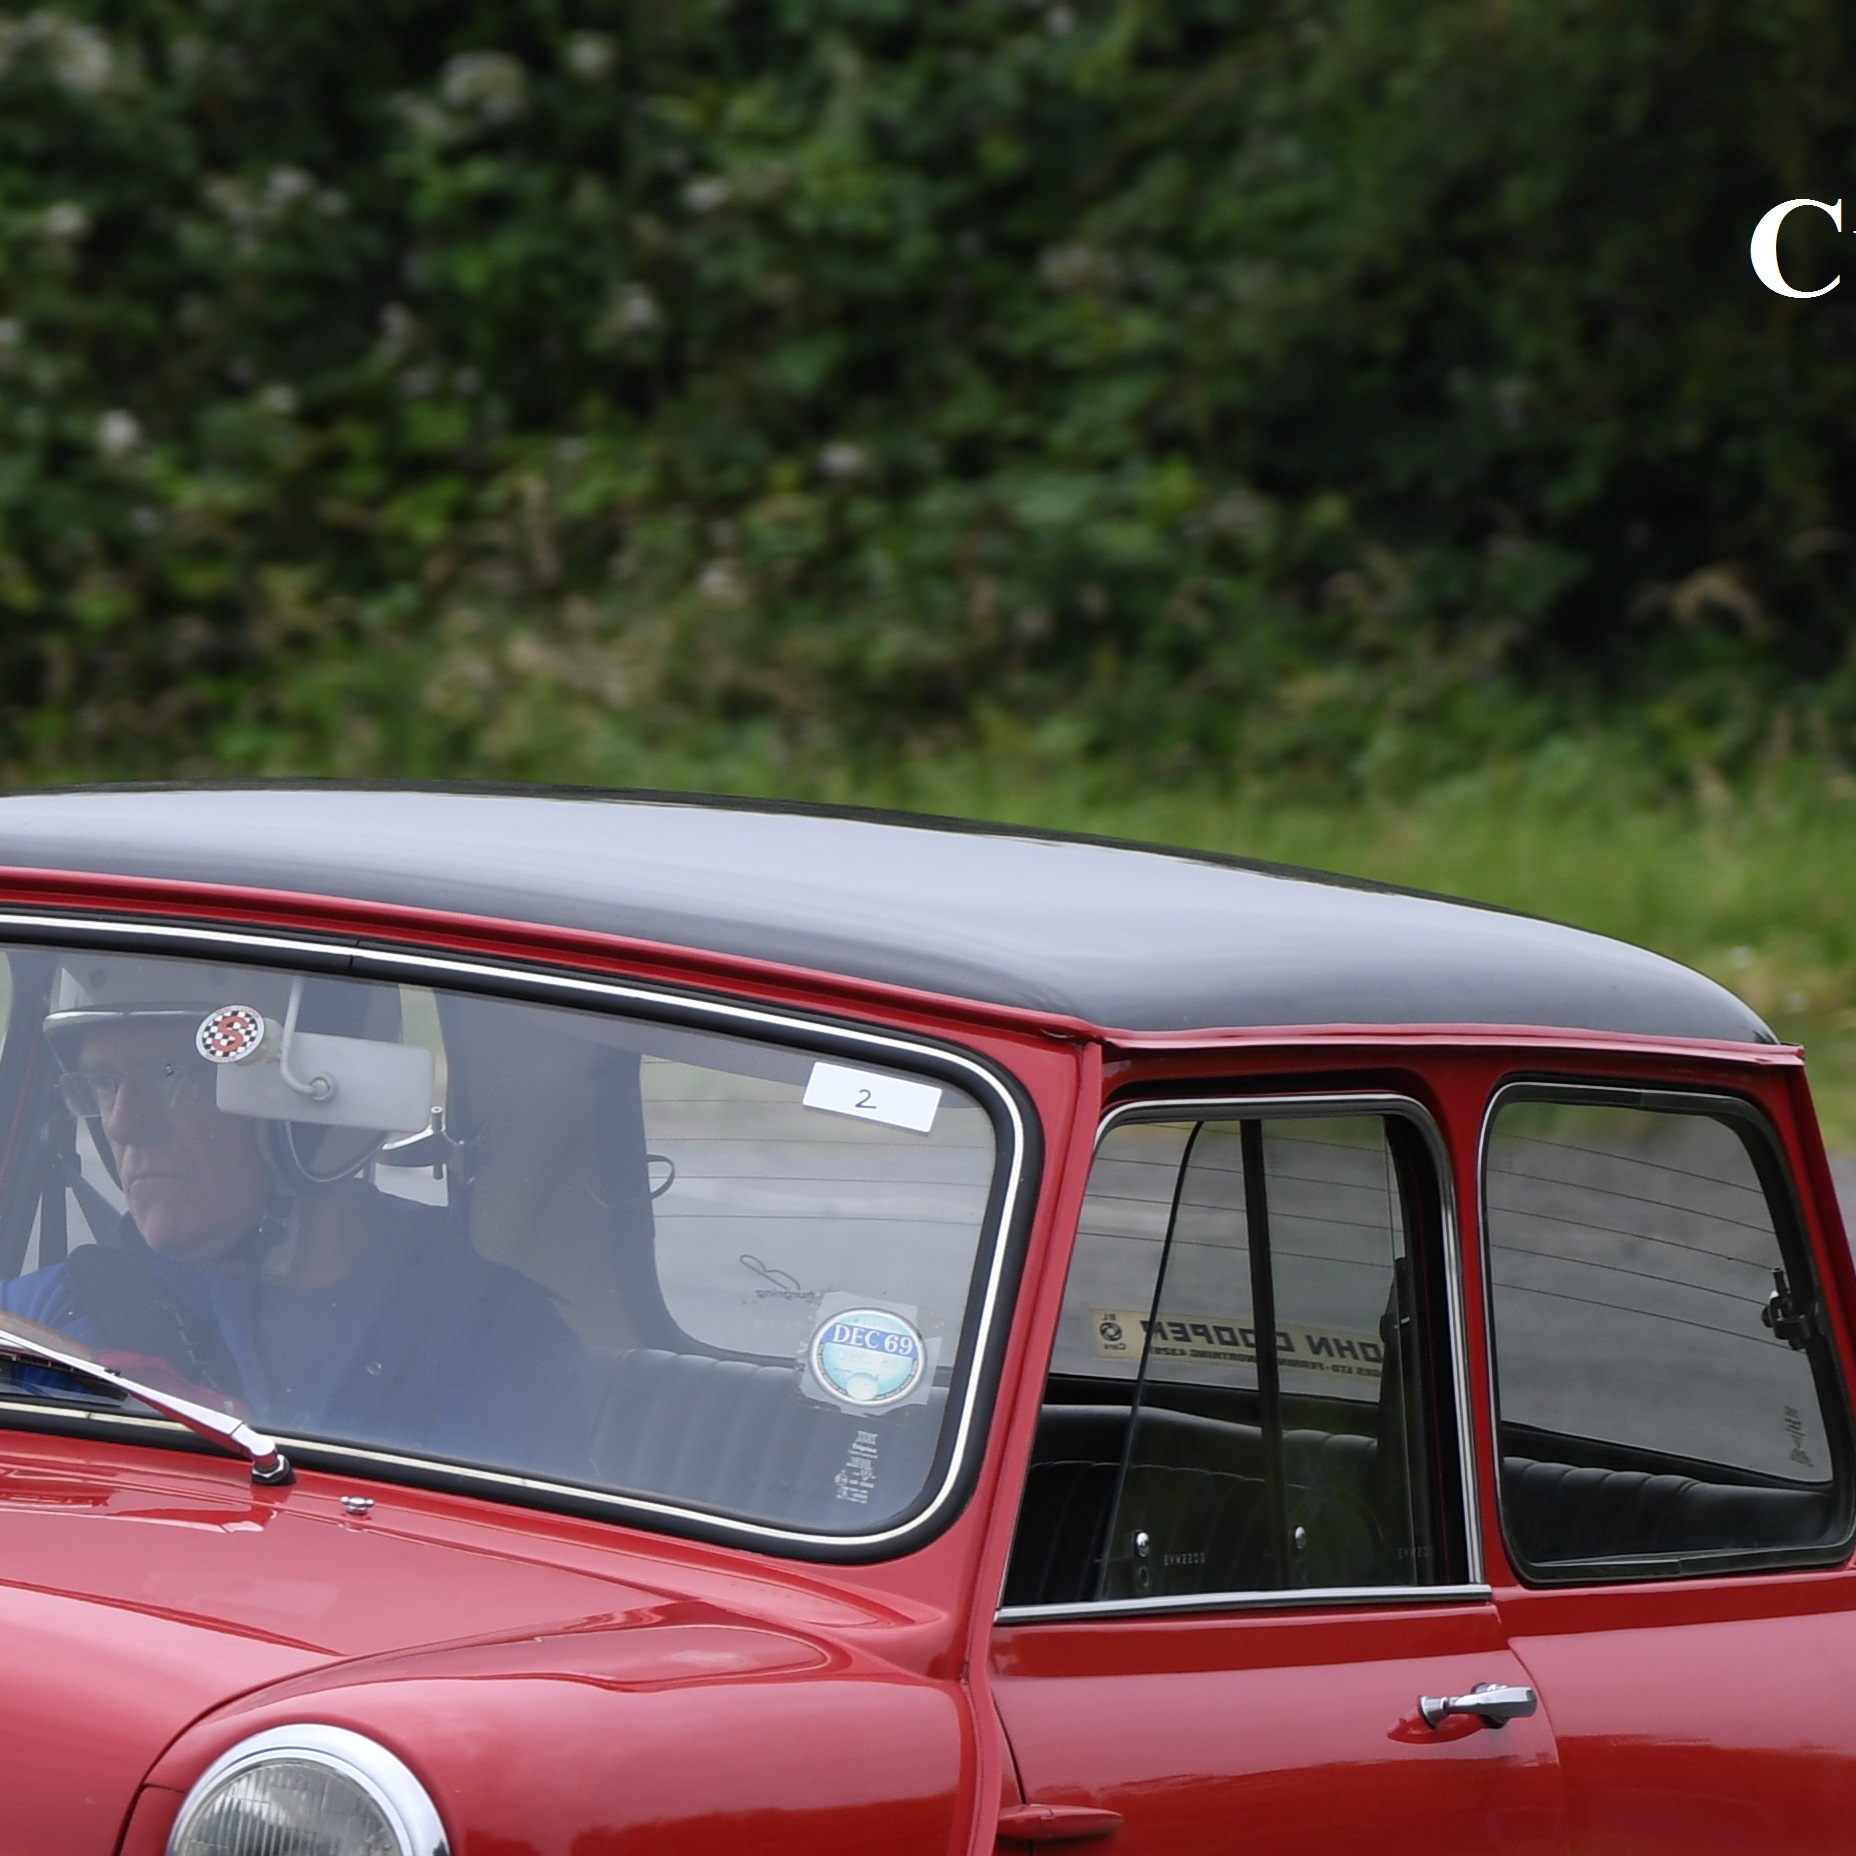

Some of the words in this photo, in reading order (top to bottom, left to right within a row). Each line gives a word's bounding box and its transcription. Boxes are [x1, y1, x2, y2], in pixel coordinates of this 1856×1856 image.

[212, 1015, 249, 1052] S
[854, 1088, 877, 1110] 2
[832, 1323, 881, 1349] DEC
[884, 1334, 913, 1356] 69
